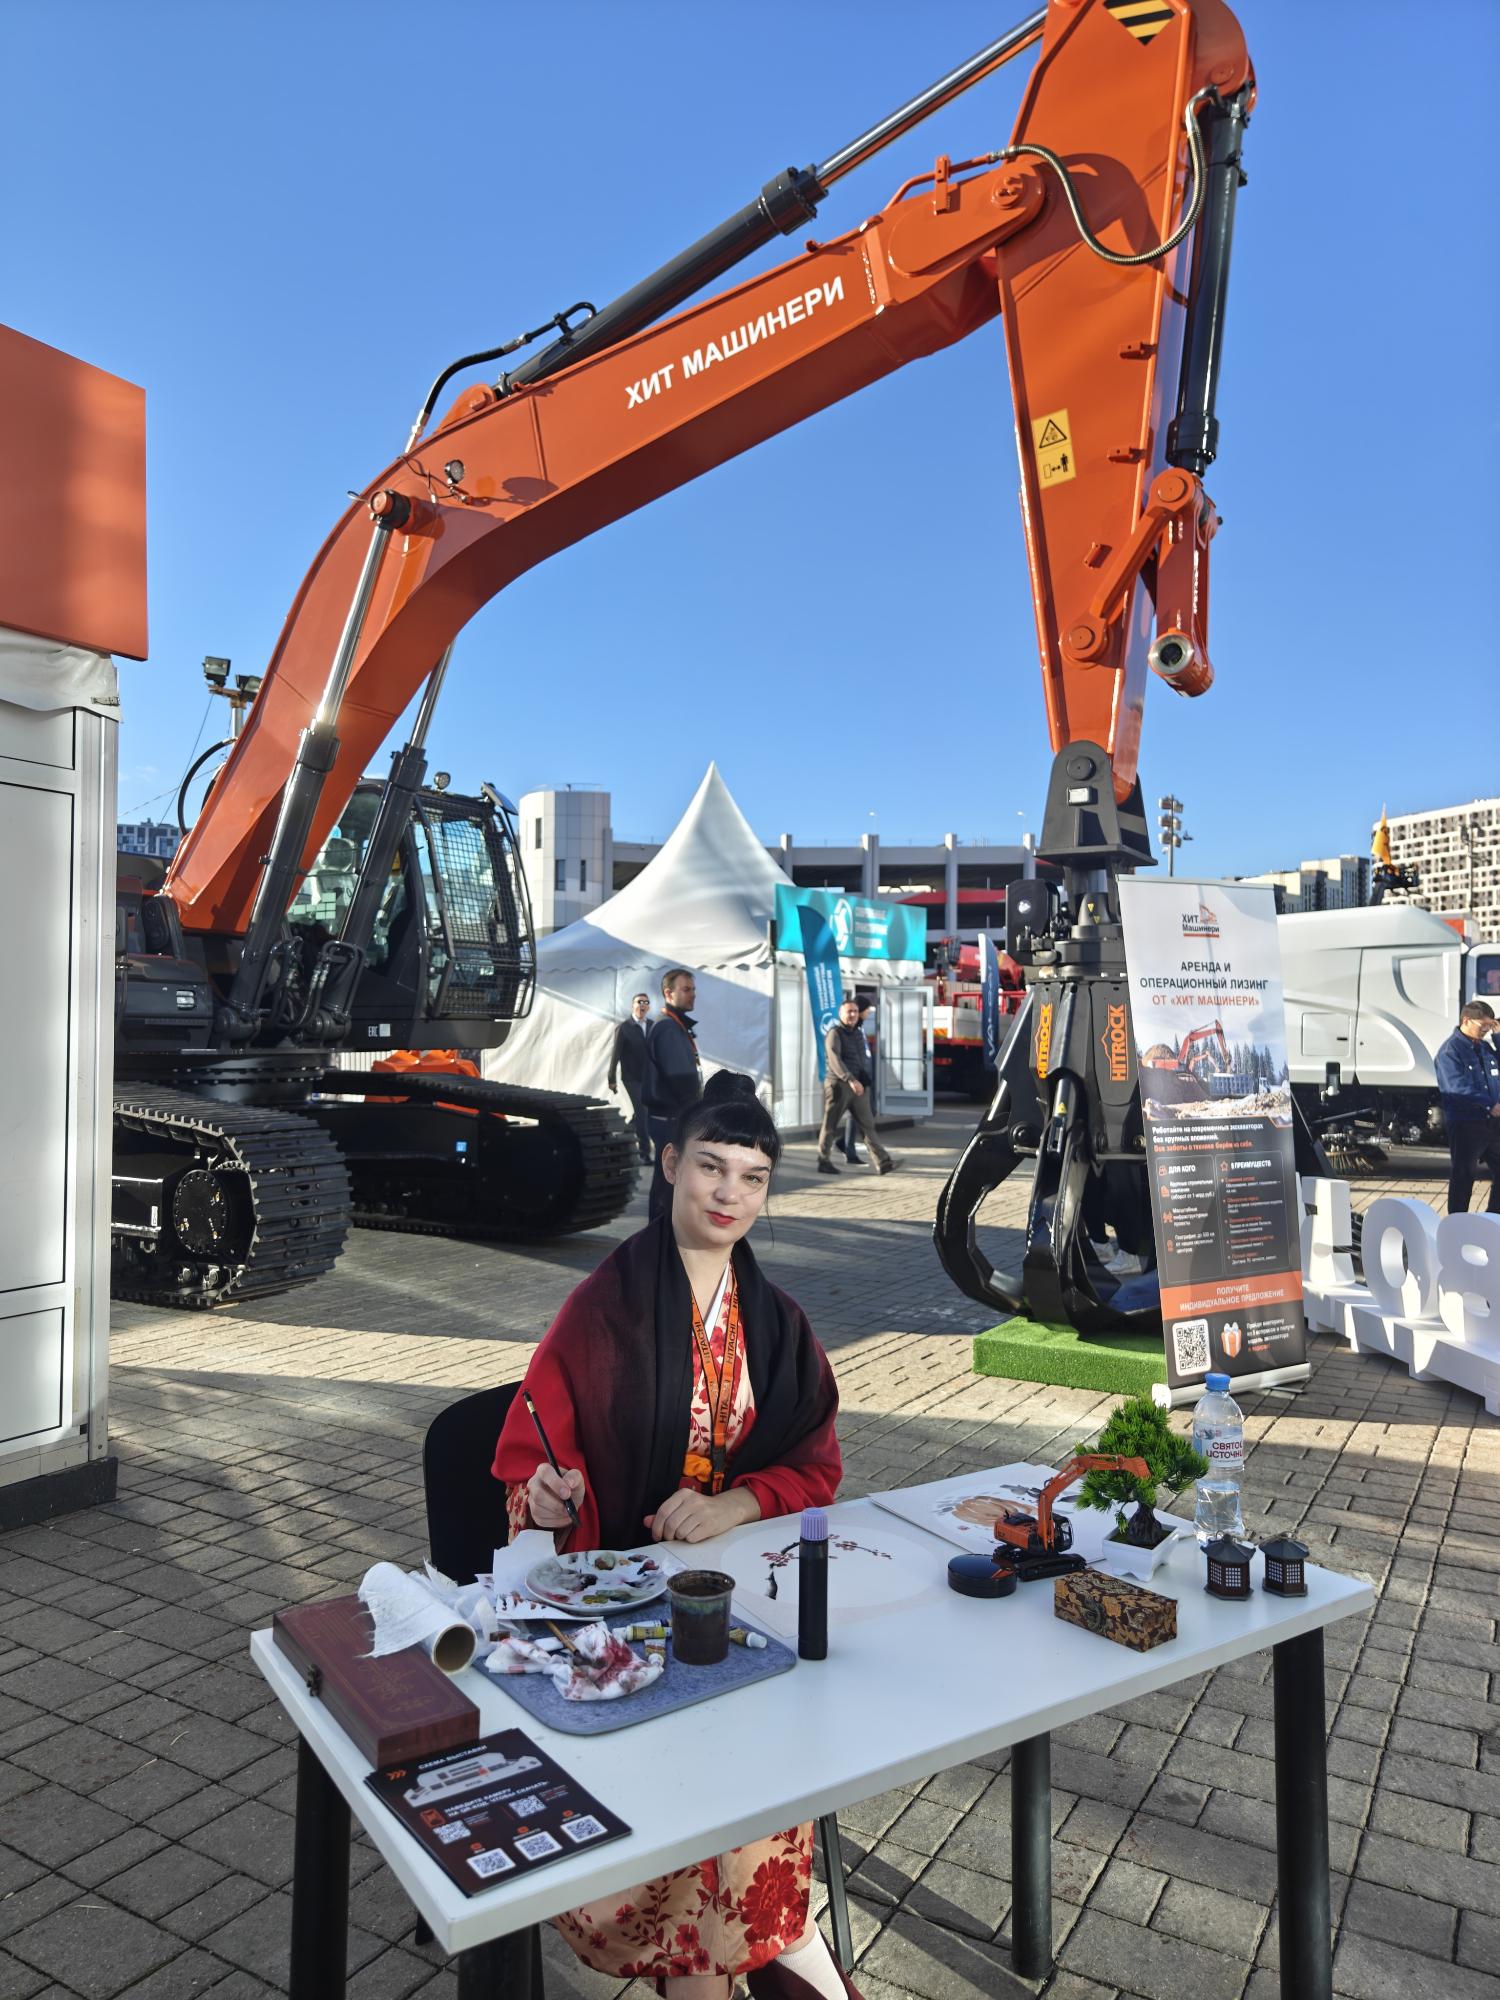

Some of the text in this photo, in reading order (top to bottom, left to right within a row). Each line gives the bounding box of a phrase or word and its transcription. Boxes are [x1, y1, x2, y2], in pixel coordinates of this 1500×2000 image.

[624, 275, 845, 410] ХИТ МАШИНЕРИ
[1182, 913, 1199, 924] ХИТ
[1182, 924, 1220, 934] Машинери
[1181, 961, 1231, 973] АРЕНДА И
[1140, 976, 1269, 990] ОПЕРАЦИОННЫЙ ЛИЗИНГ
[1152, 995, 1259, 1006] ОТ «ХИТ МАШИНЕРИ»
[1038, 1003, 1052, 1079] HITROCK
[1109, 1003, 1127, 1080] HITROCK
[1168, 1165, 1196, 1174] ДЛЯ КОГО
[1216, 1284, 1249, 1295] ПОЛУЧИТЕ
[1180, 1289, 1284, 1312] ИНДИВИДУАЛЬНОЕ ПРЕДЛОЖЕНИЕ
[695, 1321, 711, 1364] HITACHI
[726, 1323, 736, 1364] HITACHI
